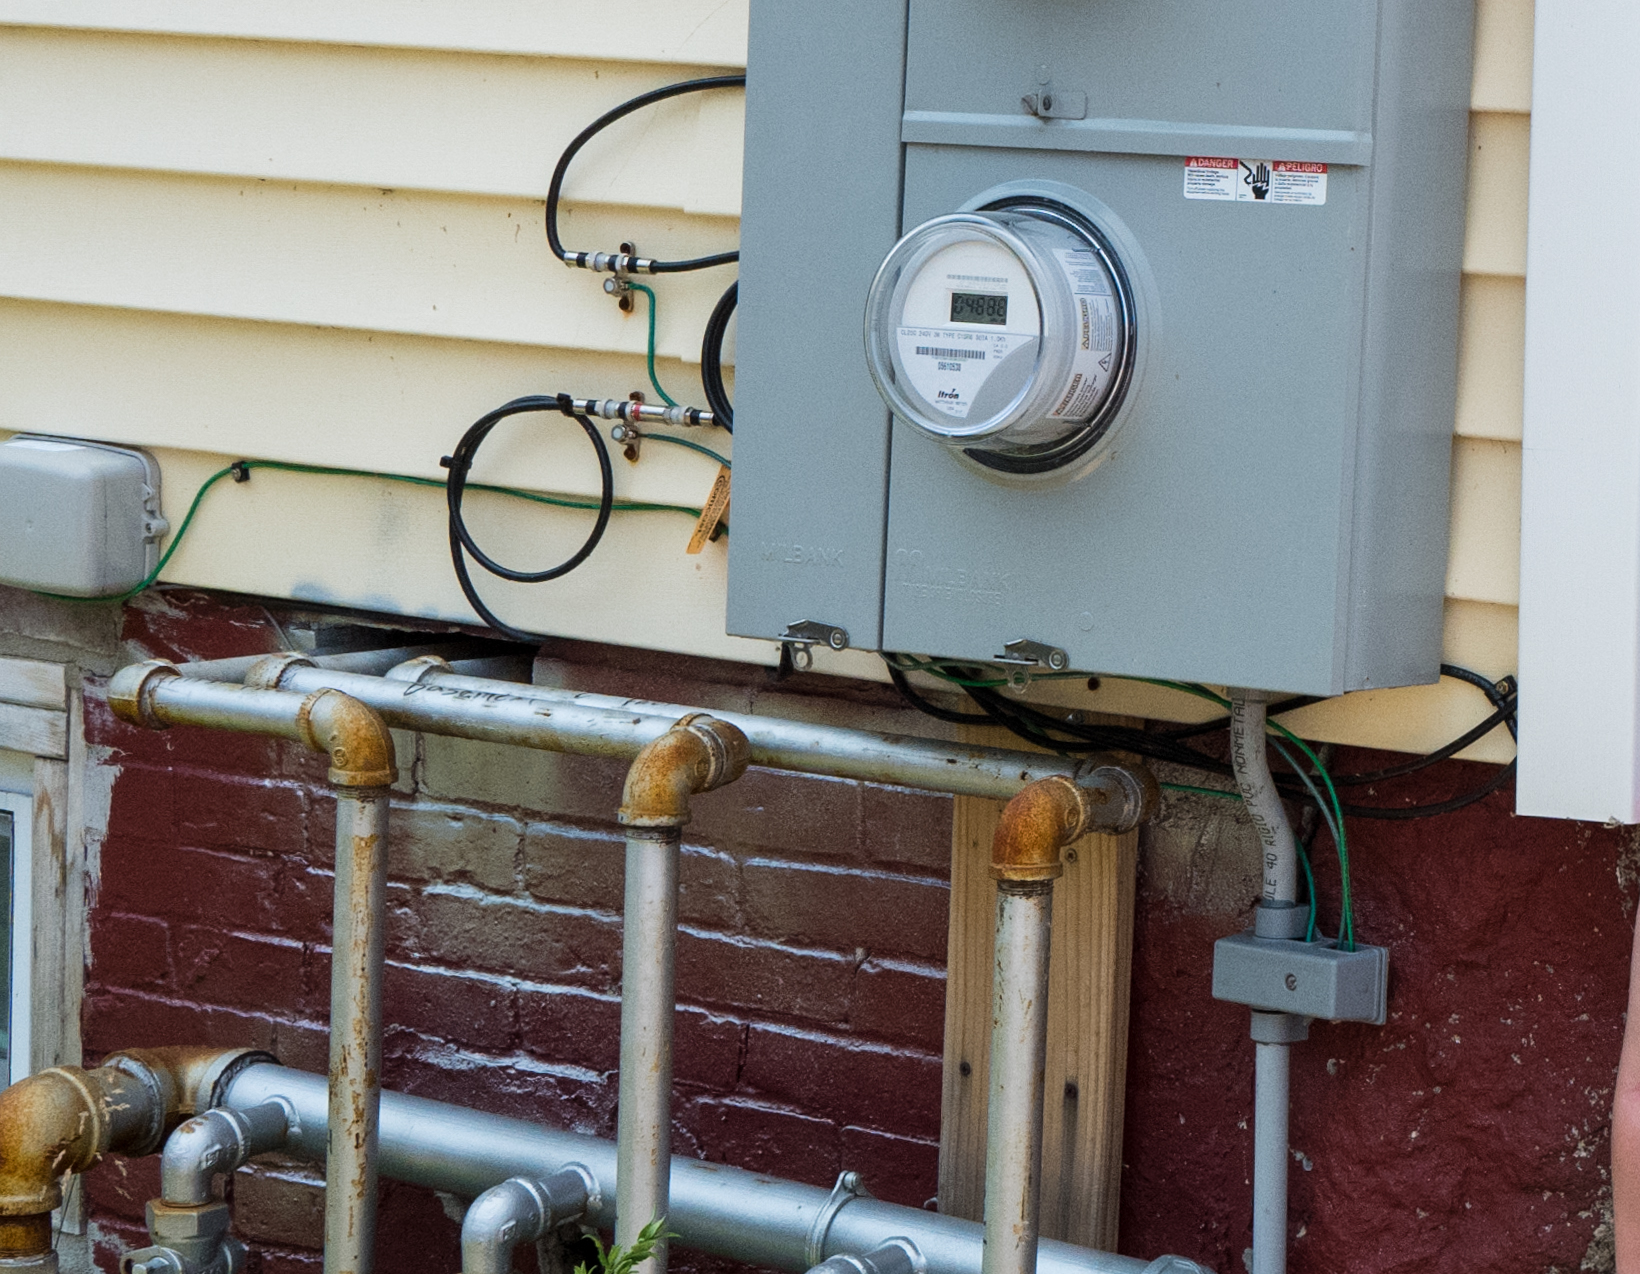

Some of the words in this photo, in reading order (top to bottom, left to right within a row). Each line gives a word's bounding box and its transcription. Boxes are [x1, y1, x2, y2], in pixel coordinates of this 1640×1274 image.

[1198, 159, 1234, 169] DANGER
[1286, 162, 1323, 173] PELIGRO
[1243, 781, 1262, 812] PVC
[1266, 852, 1278, 870] 40
